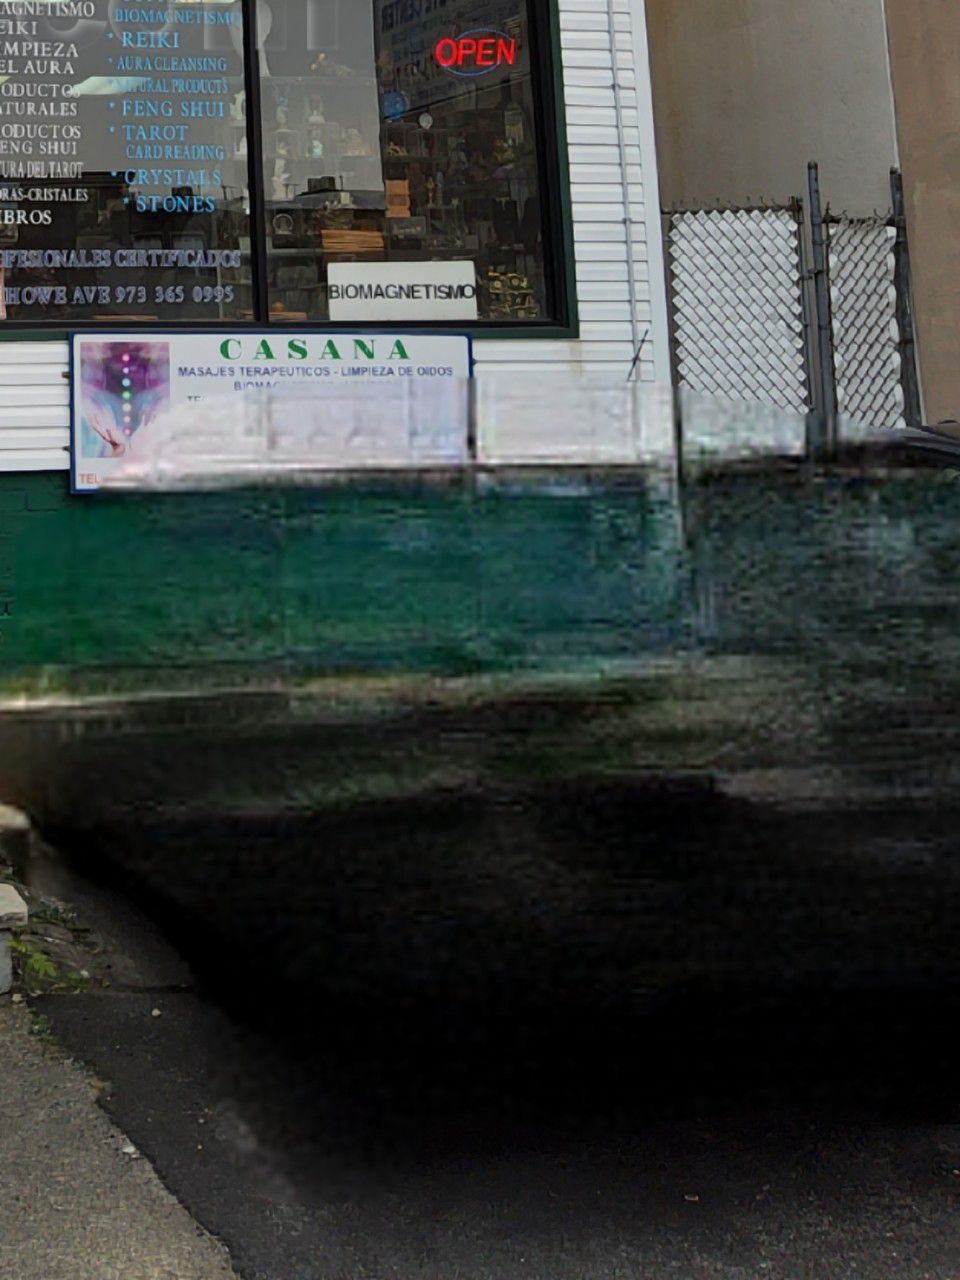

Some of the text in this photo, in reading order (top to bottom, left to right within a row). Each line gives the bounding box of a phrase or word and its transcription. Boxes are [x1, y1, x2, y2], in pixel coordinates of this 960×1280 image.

[122, 30, 180, 48] REIKI
[435, 38, 516, 66] OPEN
[24, 61, 74, 75] AURA
[117, 56, 227, 72] AURA CLEANSING
[172, 77, 228, 94] PRODUCTS
[122, 100, 225, 118] FENG SHUI
[122, 124, 189, 140] TAROT
[40, 141, 77, 155] SHUI
[126, 144, 224, 160] CARD READING
[26, 161, 47, 178] DEL
[49, 162, 84, 178] TAROT
[124, 169, 223, 186] CRYSTALS
[136, 195, 216, 213] STONES
[114, 249, 241, 268] CERTIFICADOS
[3, 286, 67, 304] HOWE
[72, 286, 111, 304] AVE
[115, 285, 147, 303] 973
[154, 285, 184, 303] 365
[327, 283, 477, 300] BIOMAGNETISMO
[219, 338, 411, 361] CASANA
[178, 366, 235, 377] MASAJES
[240, 366, 330, 377] TERAPEUTICOS
[341, 366, 394, 377] LIMPIEZA
[398, 366, 413, 377] DE
[417, 366, 453, 377] OIDOS
